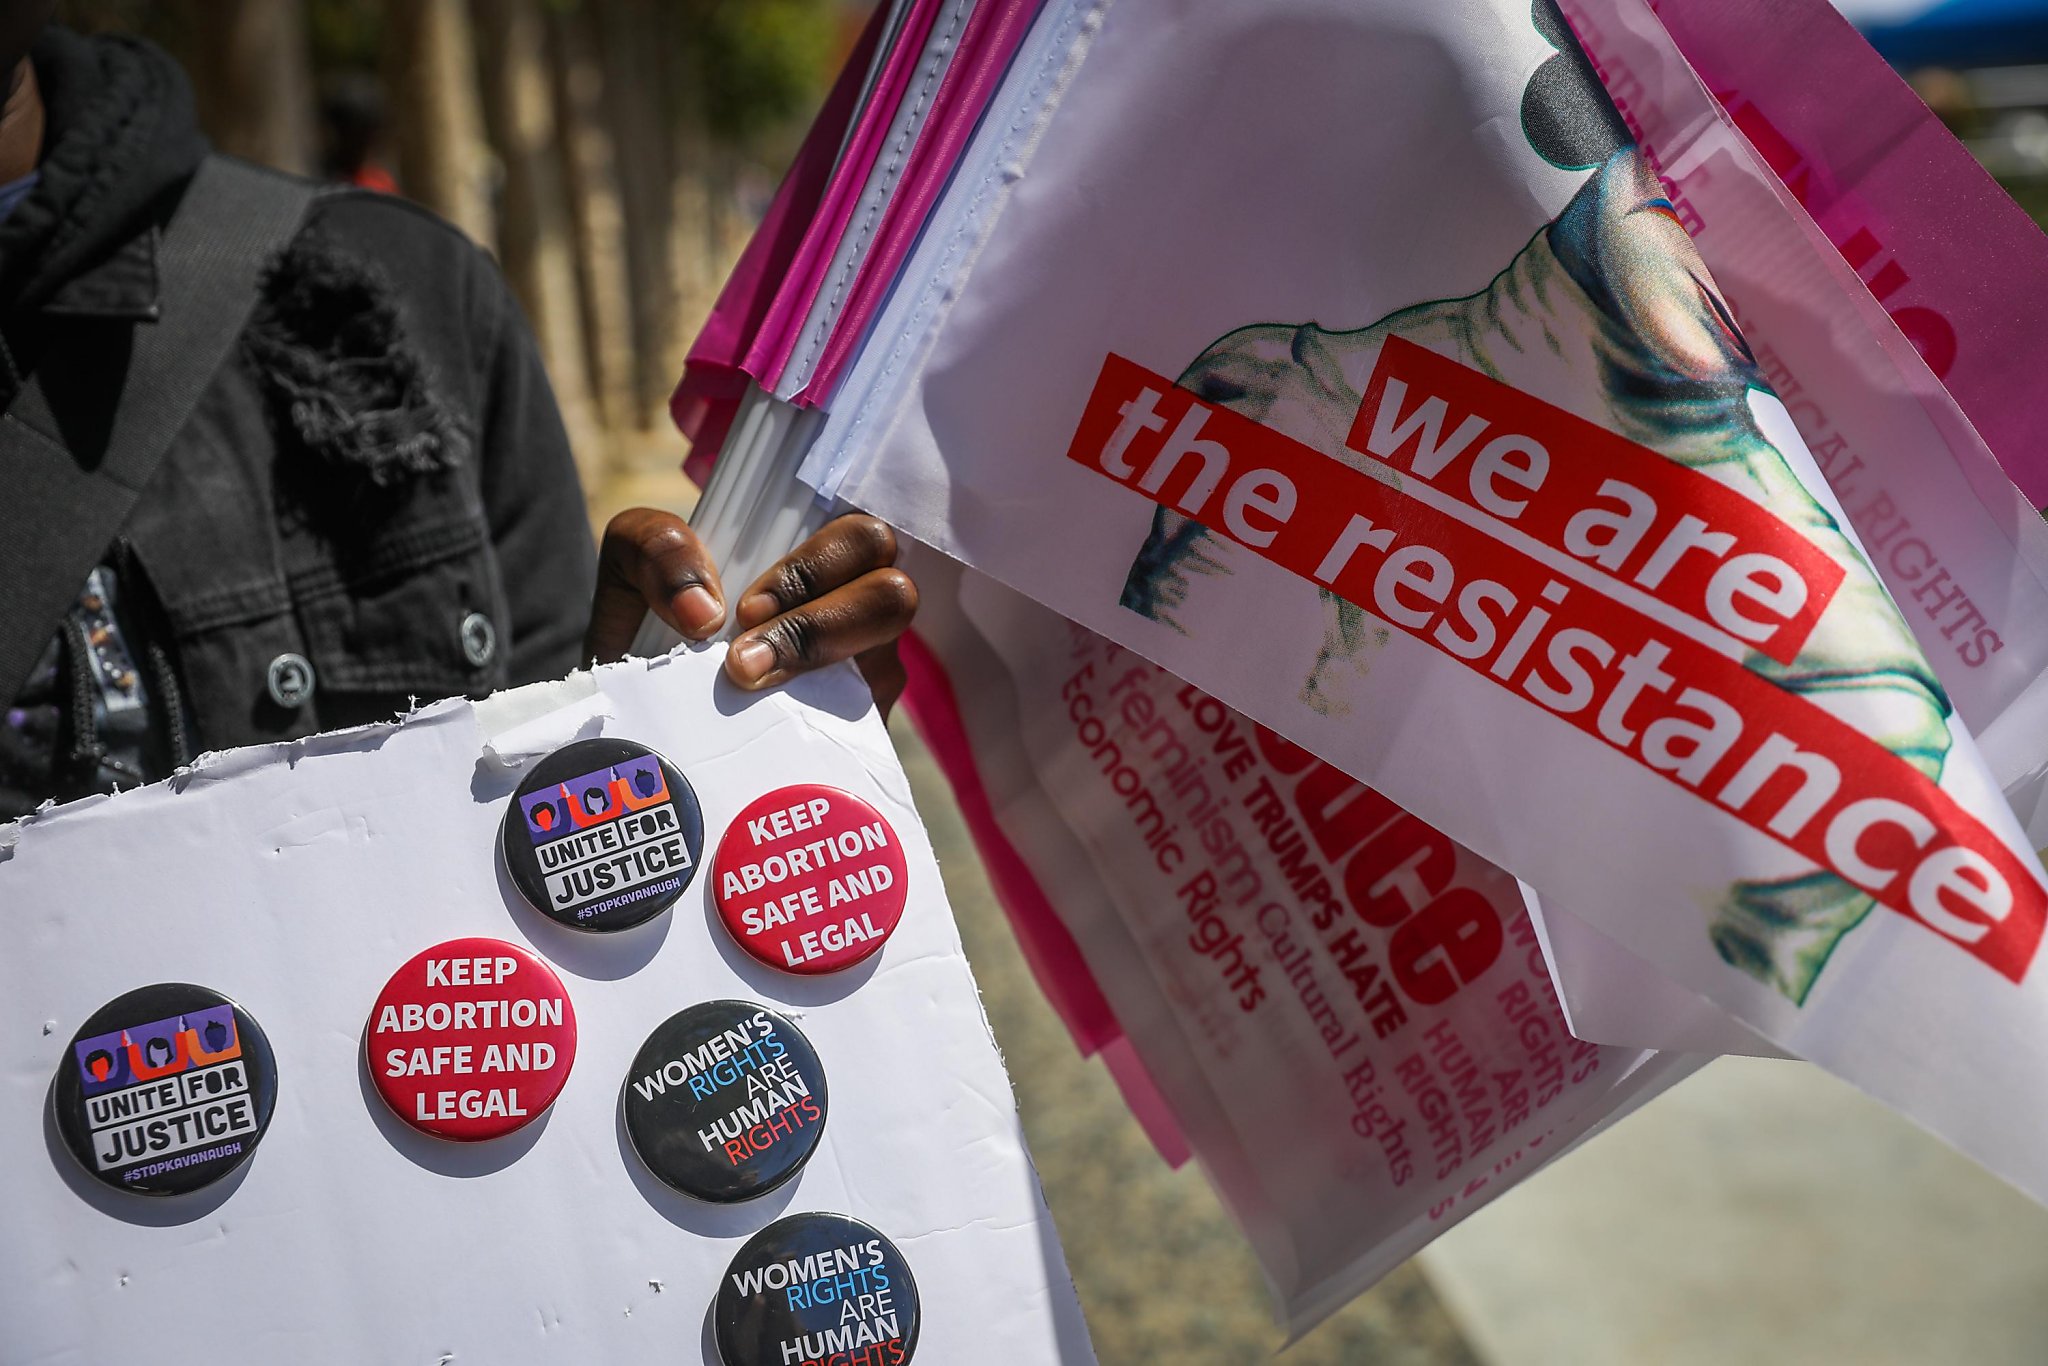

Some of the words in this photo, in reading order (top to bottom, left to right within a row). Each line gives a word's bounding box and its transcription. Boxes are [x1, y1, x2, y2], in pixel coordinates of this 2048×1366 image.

[1363, 376, 1550, 519] we
[1563, 477, 1809, 642] are
[1856, 490, 2004, 669] RIGHTS
[1099, 386, 1298, 544] the
[1312, 515, 2014, 944] resistance
[1109, 666, 1263, 907] feminism
[541, 826, 617, 869] UNITE
[624, 812, 674, 842] FOR
[748, 798, 831, 846] KEEP
[1061, 663, 1184, 874] Economic
[1176, 869, 1267, 1013] Rights
[555, 840, 686, 900] JUSTICE
[722, 822, 888, 900] ABORTION
[1176, 683, 1257, 783] LOVE
[1243, 775, 1343, 930] TRUMPS
[1329, 928, 1408, 1040] HATE
[577, 877, 681, 920] #STOPKAVANAUGH
[741, 883, 824, 935] SAFE
[828, 865, 893, 908] AND
[781, 912, 885, 967] LEGAL
[426, 957, 518, 987] KEEP
[376, 999, 563, 1034] ABORTION
[1256, 902, 1360, 1059] Cultural
[1343, 1057, 1414, 1187] Rights
[1497, 979, 1563, 1108] RIGHTS
[385, 1045, 476, 1077] SAFE
[479, 1042, 557, 1073] AND
[632, 1011, 773, 1102] WOMEN'S
[688, 1032, 785, 1101] RIGHTS
[745, 1052, 798, 1100] ARE
[93, 1082, 177, 1123] UNITE
[188, 1067, 243, 1099] FOR
[416, 1088, 527, 1121] LEGAL
[697, 1074, 810, 1153] HUMAN
[1395, 1053, 1463, 1182] RIGHTS
[1423, 1018, 1497, 1159] HUMAN
[1492, 1069, 1530, 1134] ARE
[101, 1102, 251, 1164] JUSTICE
[724, 1096, 821, 1166] RIGHTS
[123, 1142, 242, 1183] #STOPKAVANAUGH
[732, 1239, 884, 1298] WOMEN'S
[786, 1264, 890, 1312] RIGHTS
[840, 1289, 896, 1326] ARE
[780, 1314, 900, 1366] HUMAN
[800, 1338, 906, 1366] GHTS
